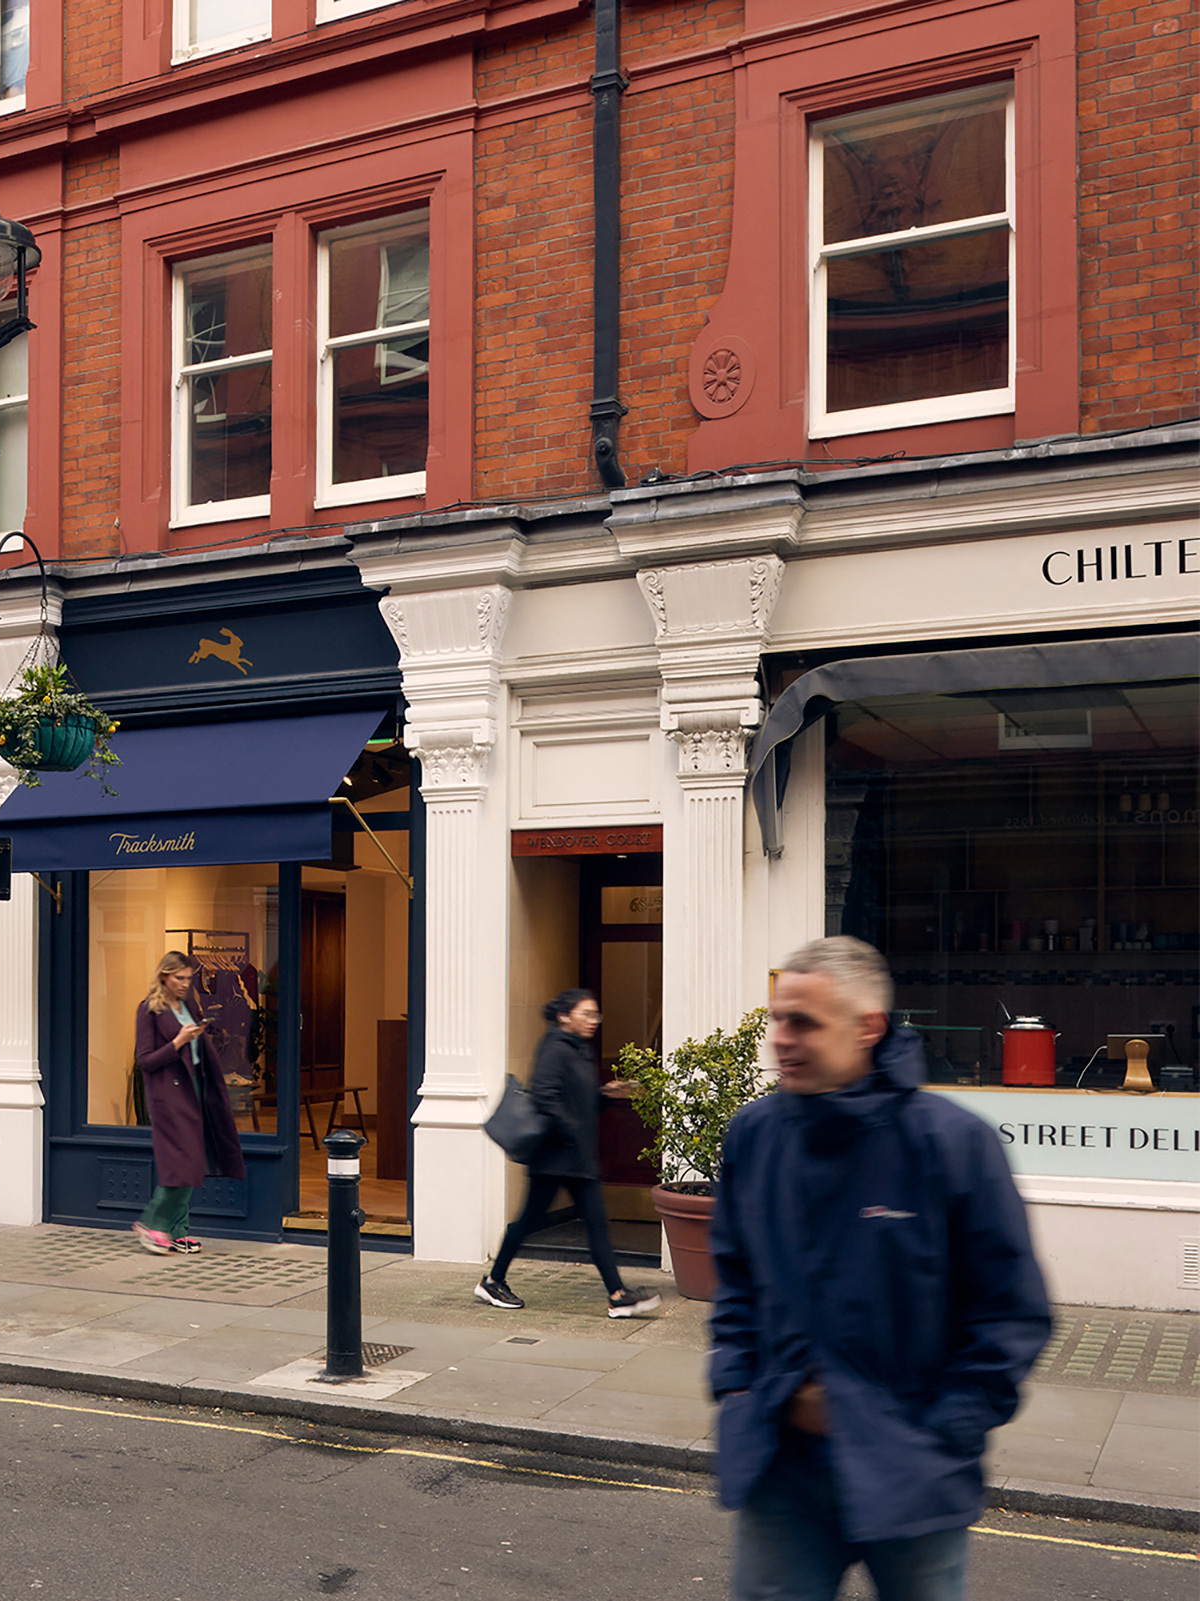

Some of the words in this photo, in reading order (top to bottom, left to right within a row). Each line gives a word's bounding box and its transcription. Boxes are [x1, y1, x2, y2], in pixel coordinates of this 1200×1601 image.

[1042, 537, 1200, 585] CHILTE
[108, 831, 195, 856] Tracksmith
[527, 834, 599, 849] WENDOVER
[605, 832, 652, 846] COURT
[999, 1122, 1118, 1148] STREET
[1129, 1127, 1200, 1152] DELI
